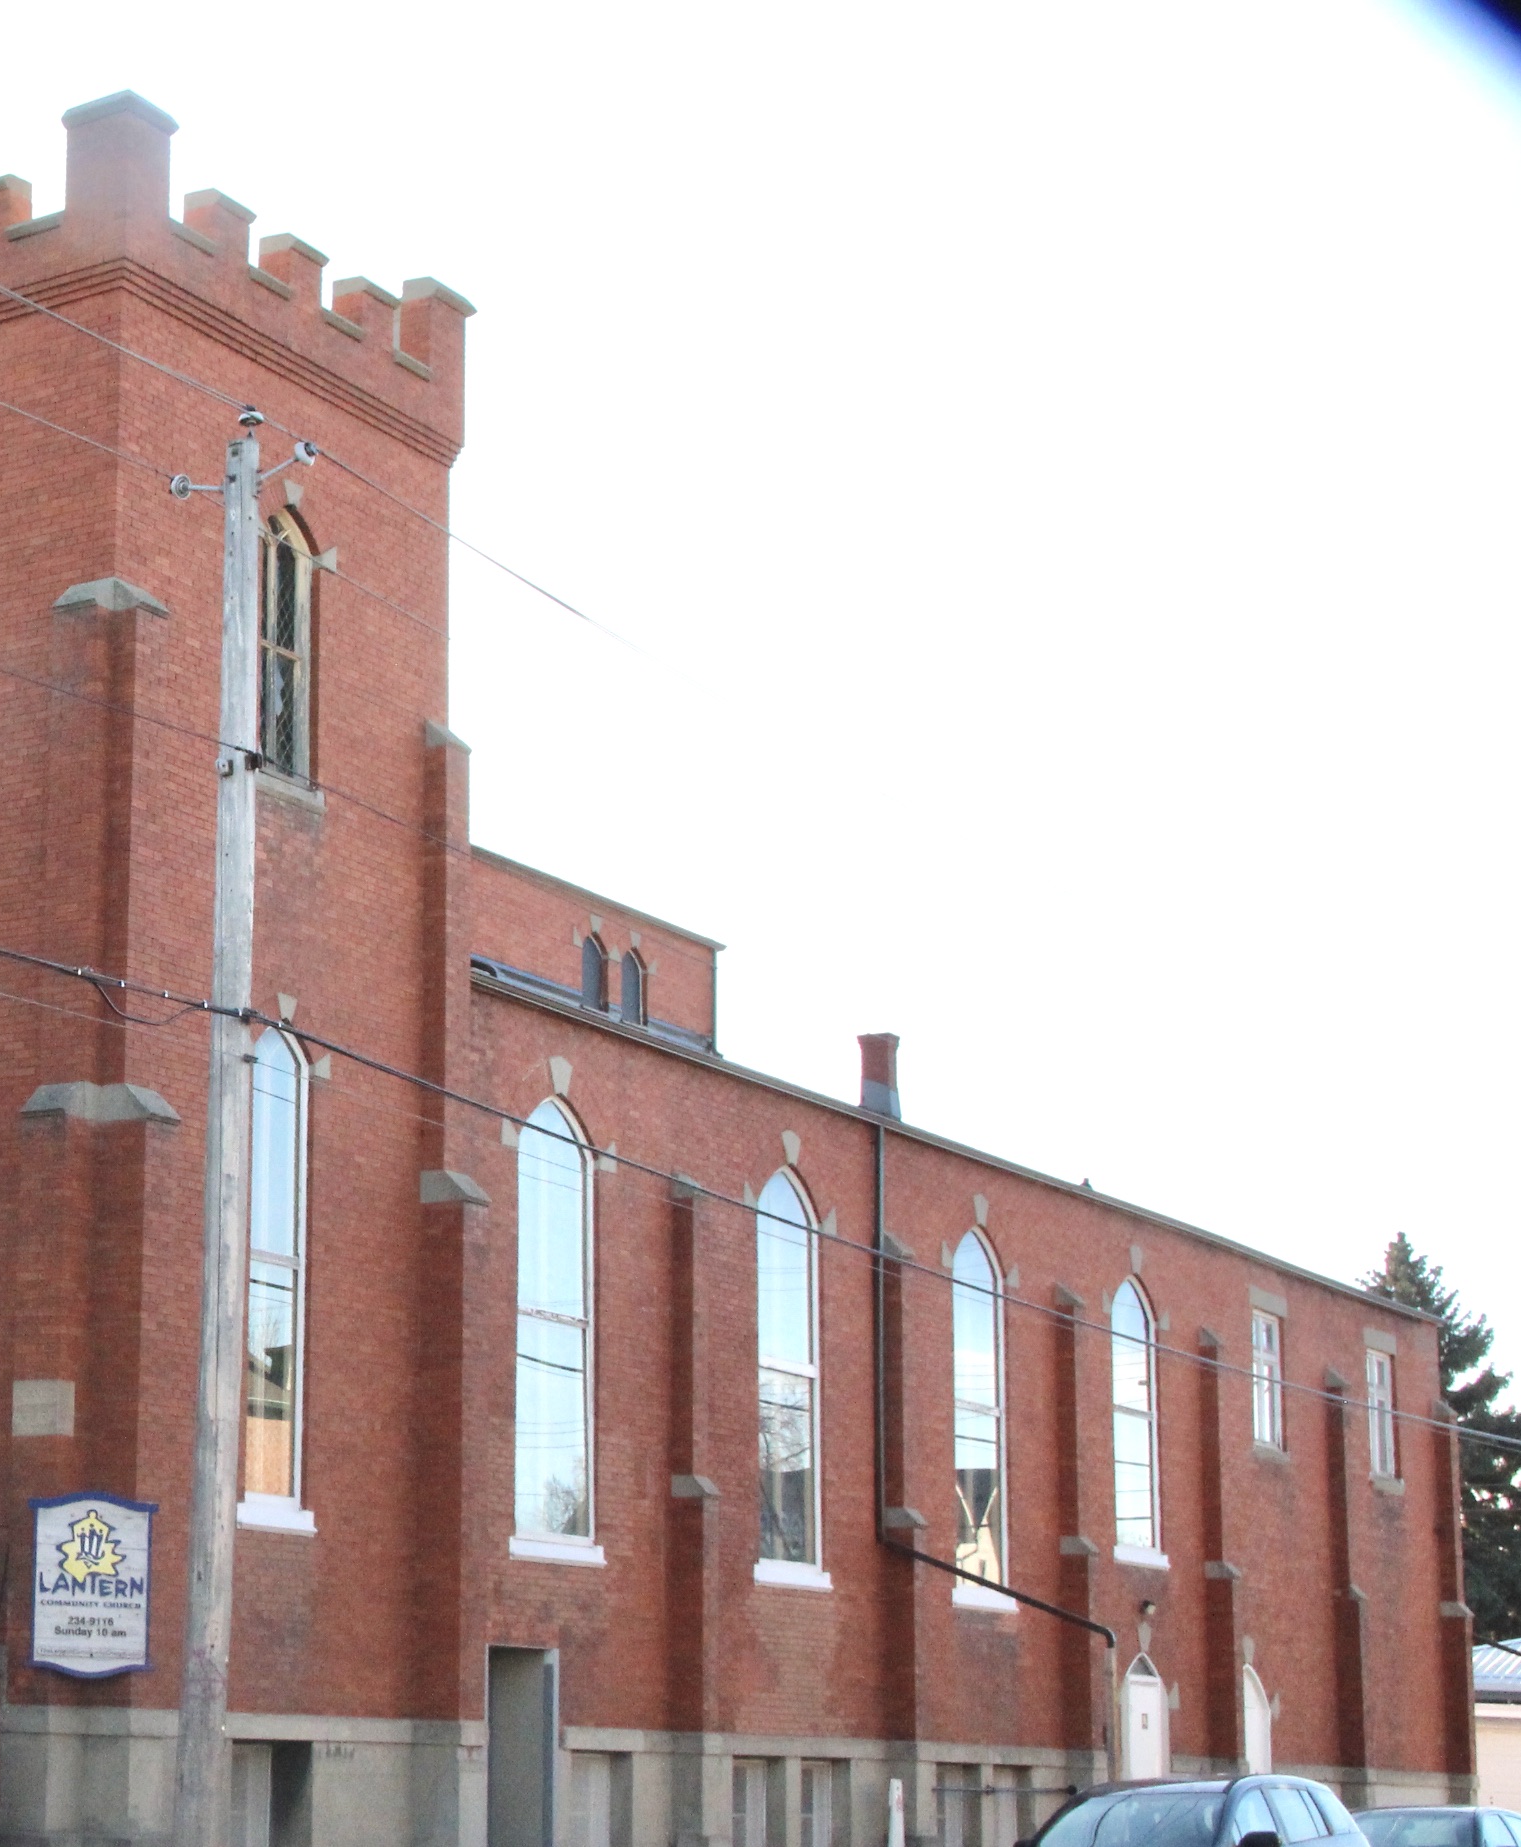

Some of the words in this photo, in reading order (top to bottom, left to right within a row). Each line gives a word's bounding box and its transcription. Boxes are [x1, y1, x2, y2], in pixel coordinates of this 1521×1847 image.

[39, 1571, 144, 1599] LANTERN
[40, 1600, 99, 1608] COMMUNITY
[103, 1601, 141, 1609] CHURCH
[54, 1625, 93, 1638] Sunday
[97, 1628, 108, 1636] 10
